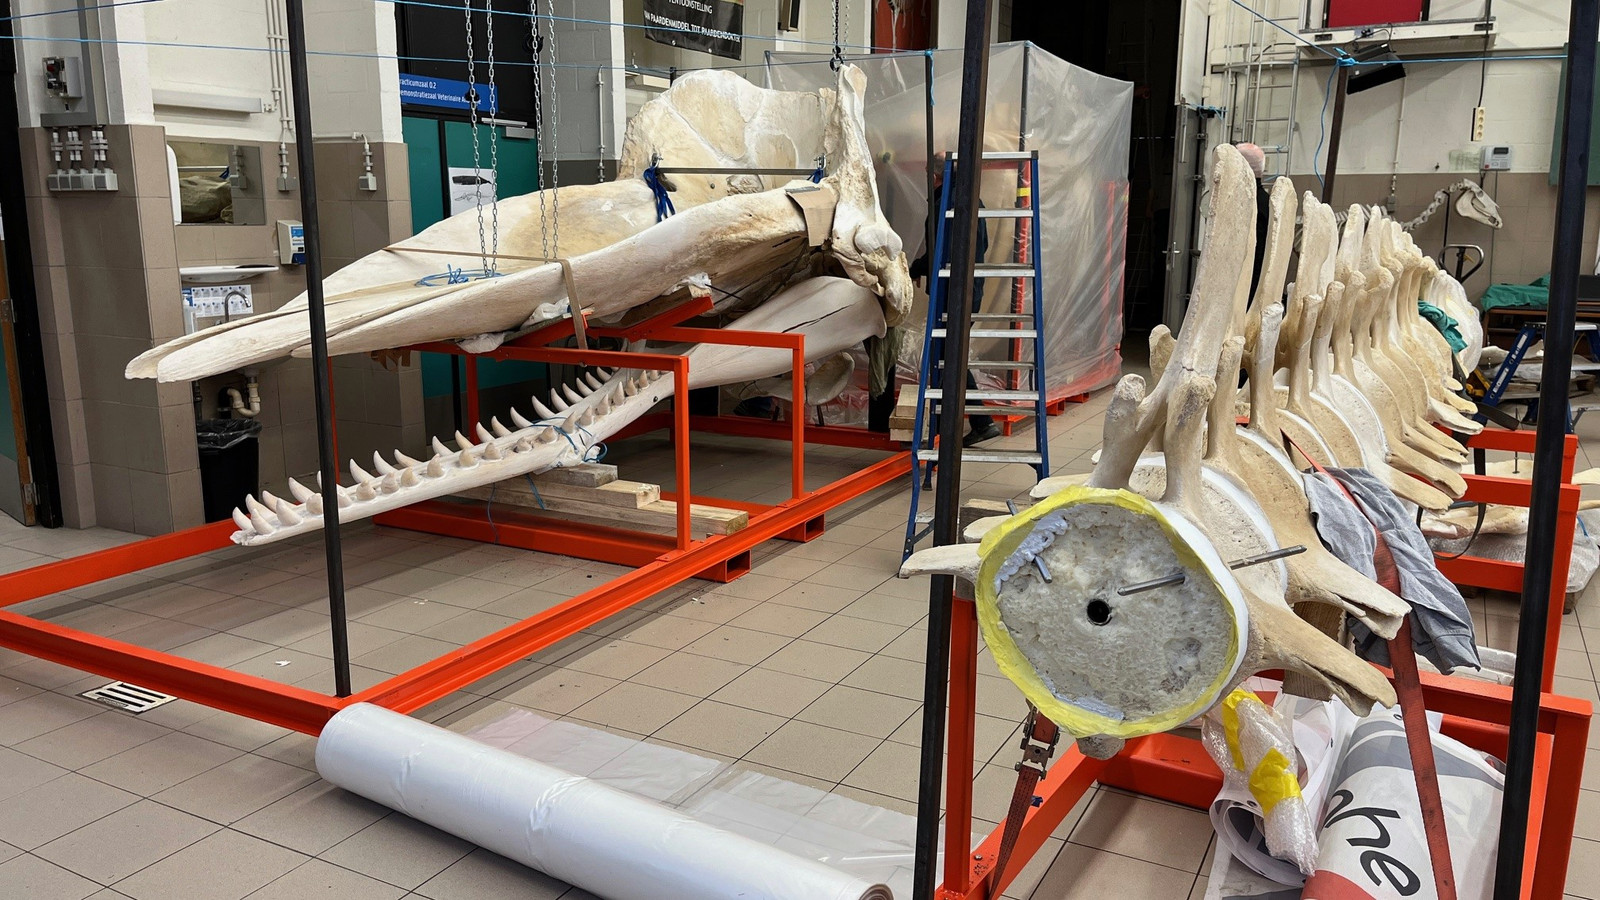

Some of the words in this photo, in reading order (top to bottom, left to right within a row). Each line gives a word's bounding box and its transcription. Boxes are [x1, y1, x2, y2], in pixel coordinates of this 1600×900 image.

[668, 0, 713, 14] NTOONSTELLING
[650, 14, 690, 32] PAARDENMIDDEL
[691, 24, 700, 34] TOT
[400, 78, 429, 88] racticumzaal
[400, 90, 437, 99] emonstratiezaal
